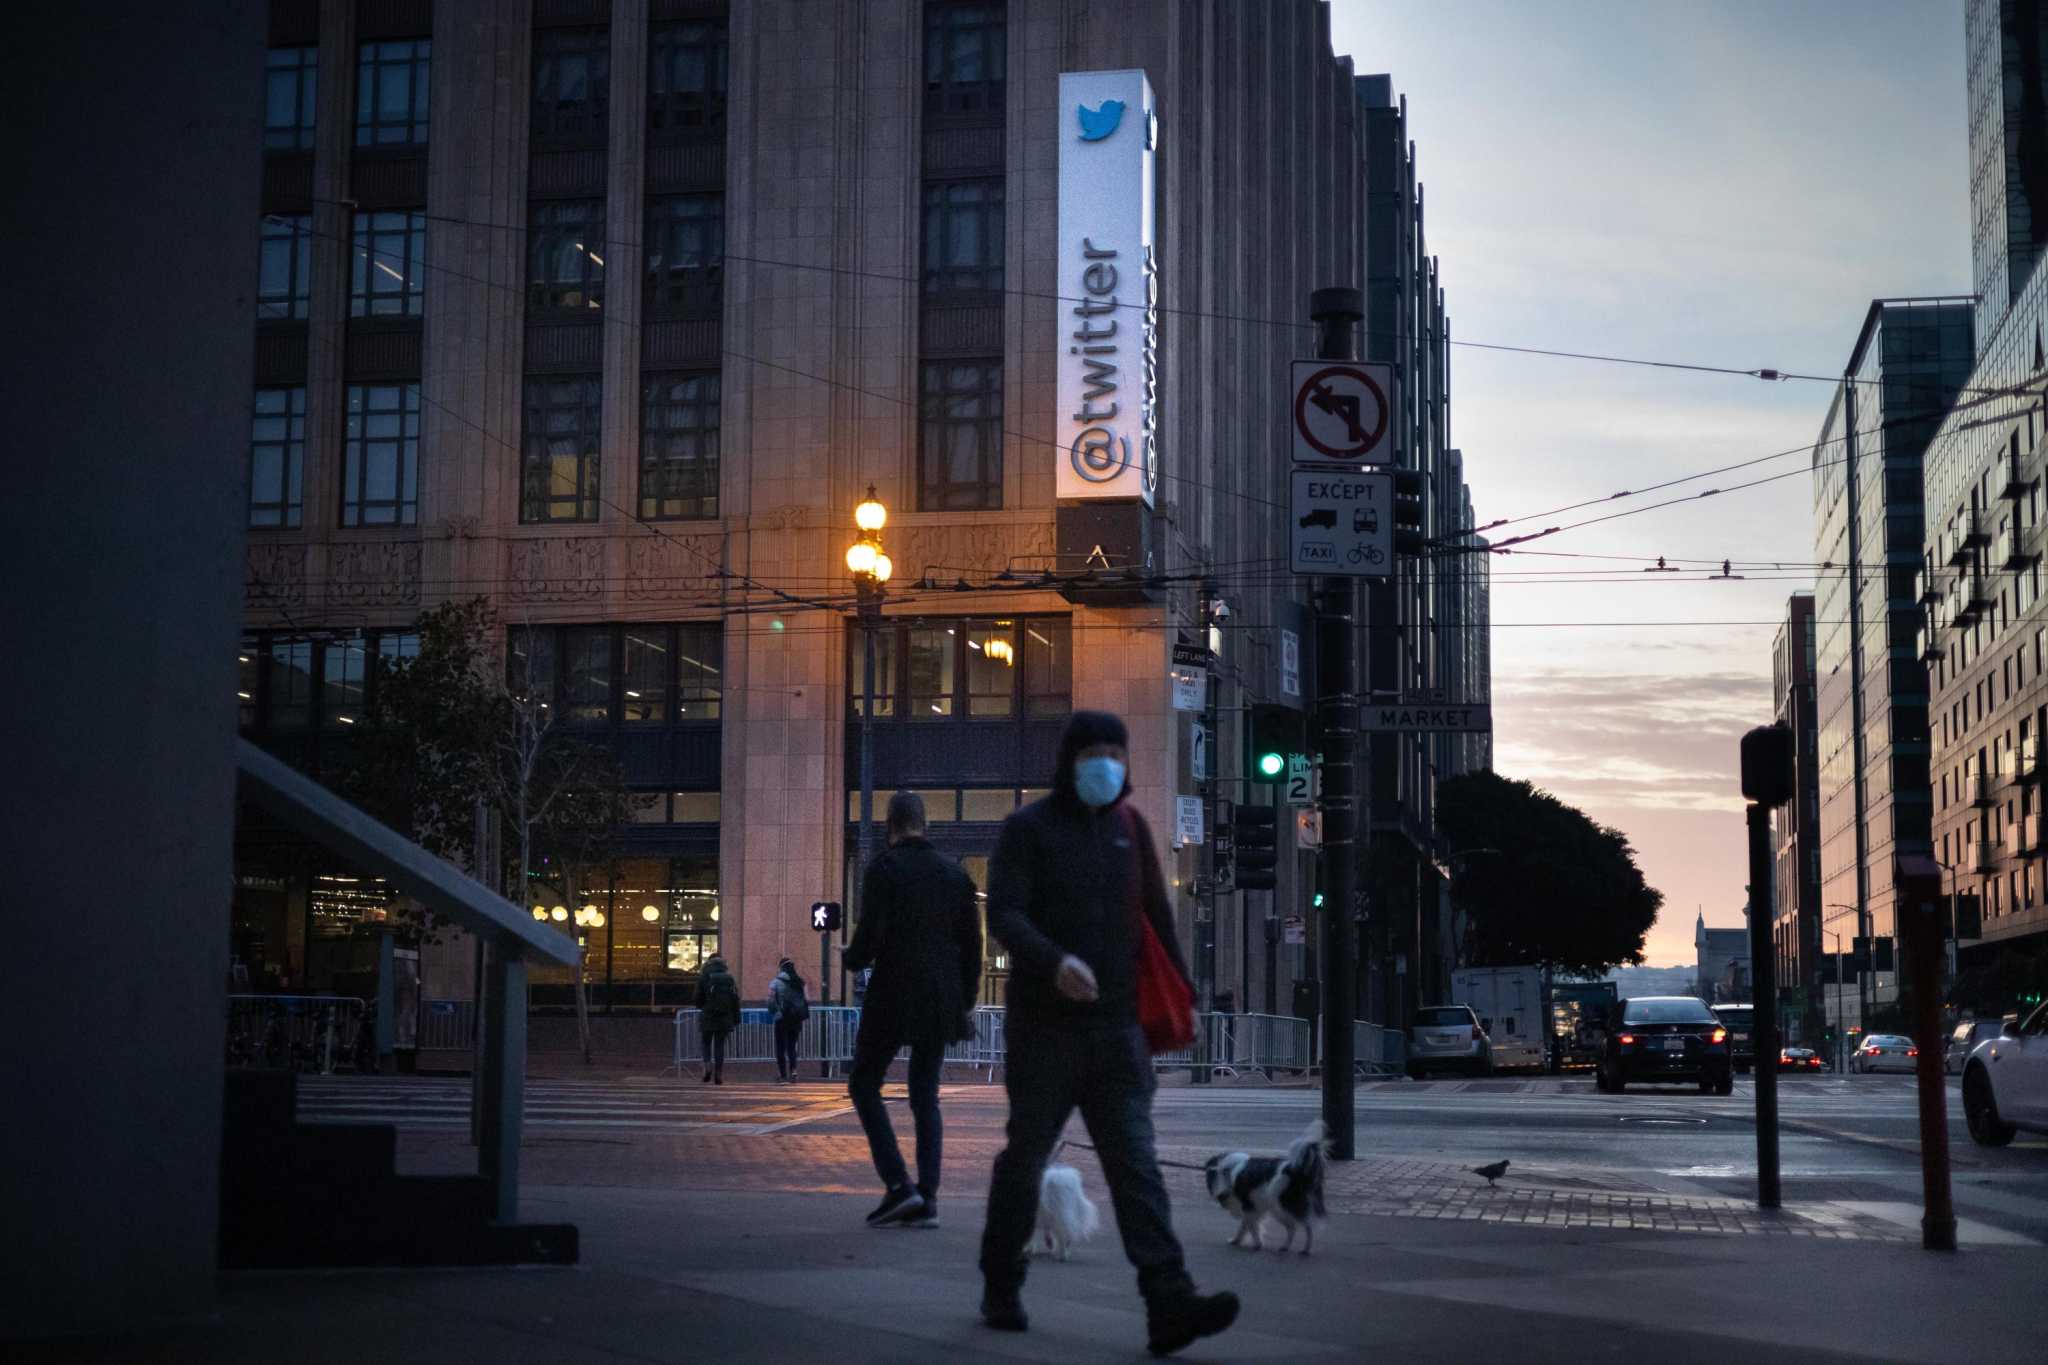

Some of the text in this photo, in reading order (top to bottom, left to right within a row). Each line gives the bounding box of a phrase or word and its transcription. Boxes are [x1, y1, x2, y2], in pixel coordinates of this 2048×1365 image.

[1070, 237, 1128, 483] @twitter
[1308, 482, 1375, 500] EXCEPT
[1303, 547, 1332, 558] TAXI
[1381, 710, 1472, 726] MARKET
